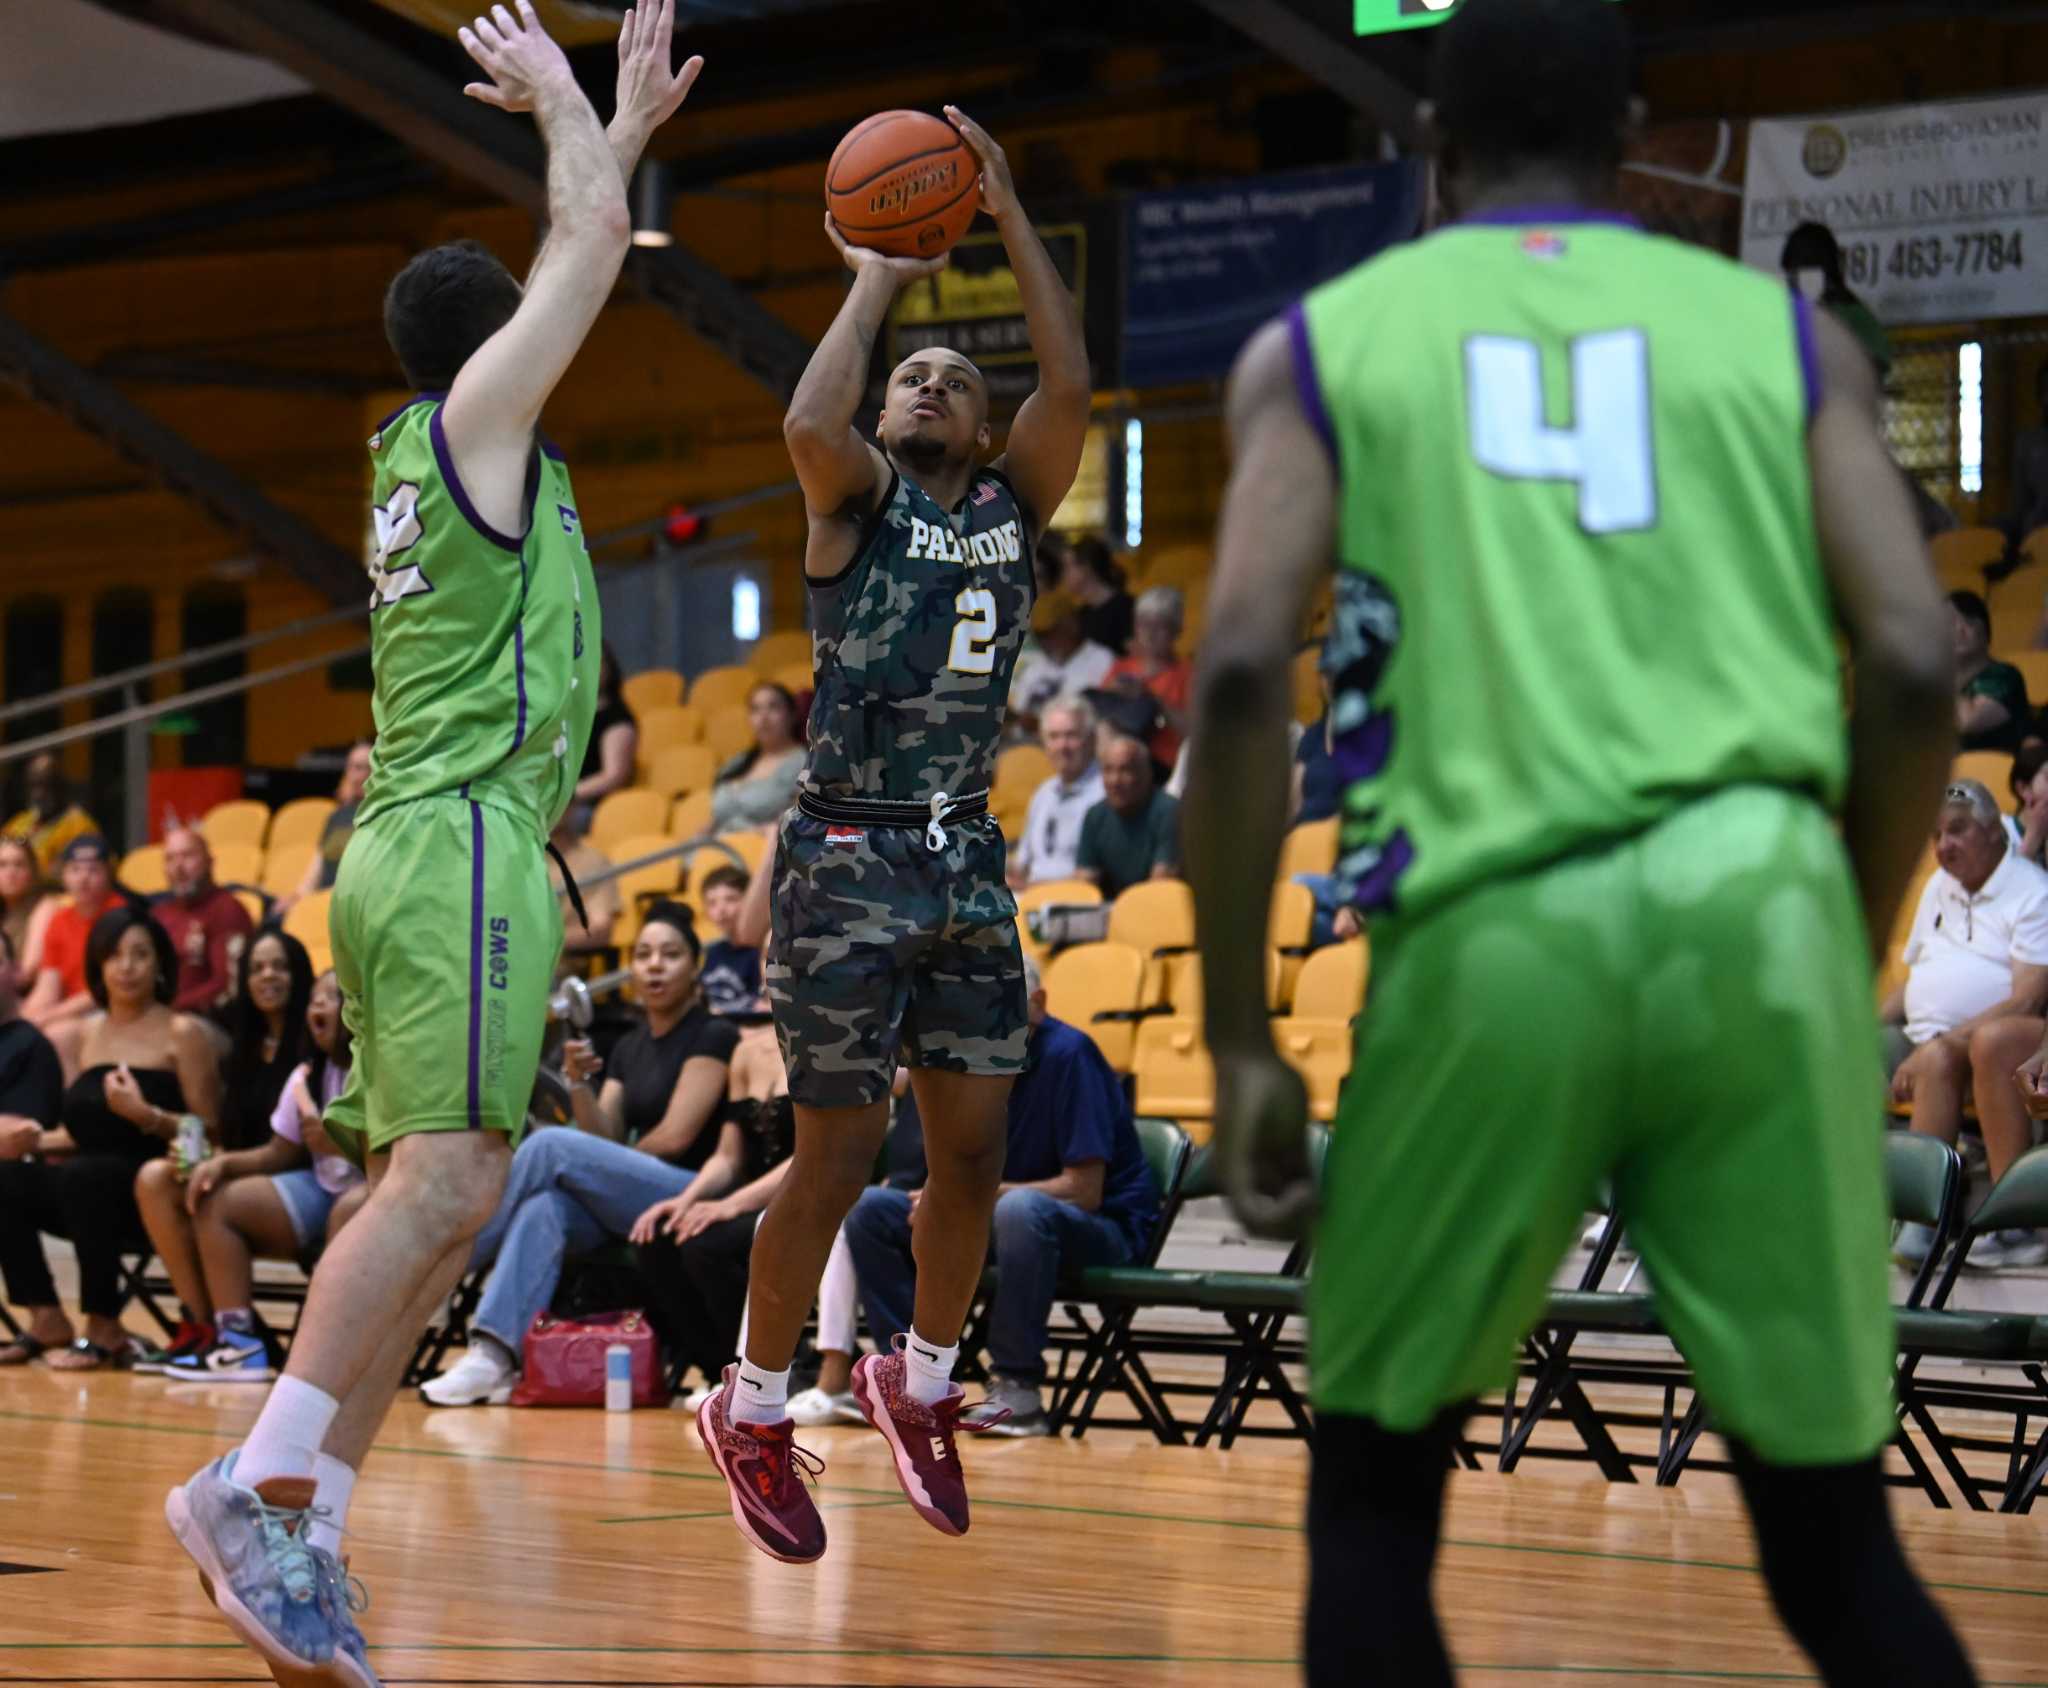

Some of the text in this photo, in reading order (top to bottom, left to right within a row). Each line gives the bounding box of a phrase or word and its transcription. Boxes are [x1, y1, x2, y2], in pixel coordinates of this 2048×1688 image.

[1753, 186, 1896, 231] PERSONAL
[1909, 176, 2018, 217] INJURY
[1887, 228, 2024, 281] 463-7784
[1461, 325, 1657, 533] 4
[947, 587, 996, 675] 2
[489, 916, 510, 991] COWS
